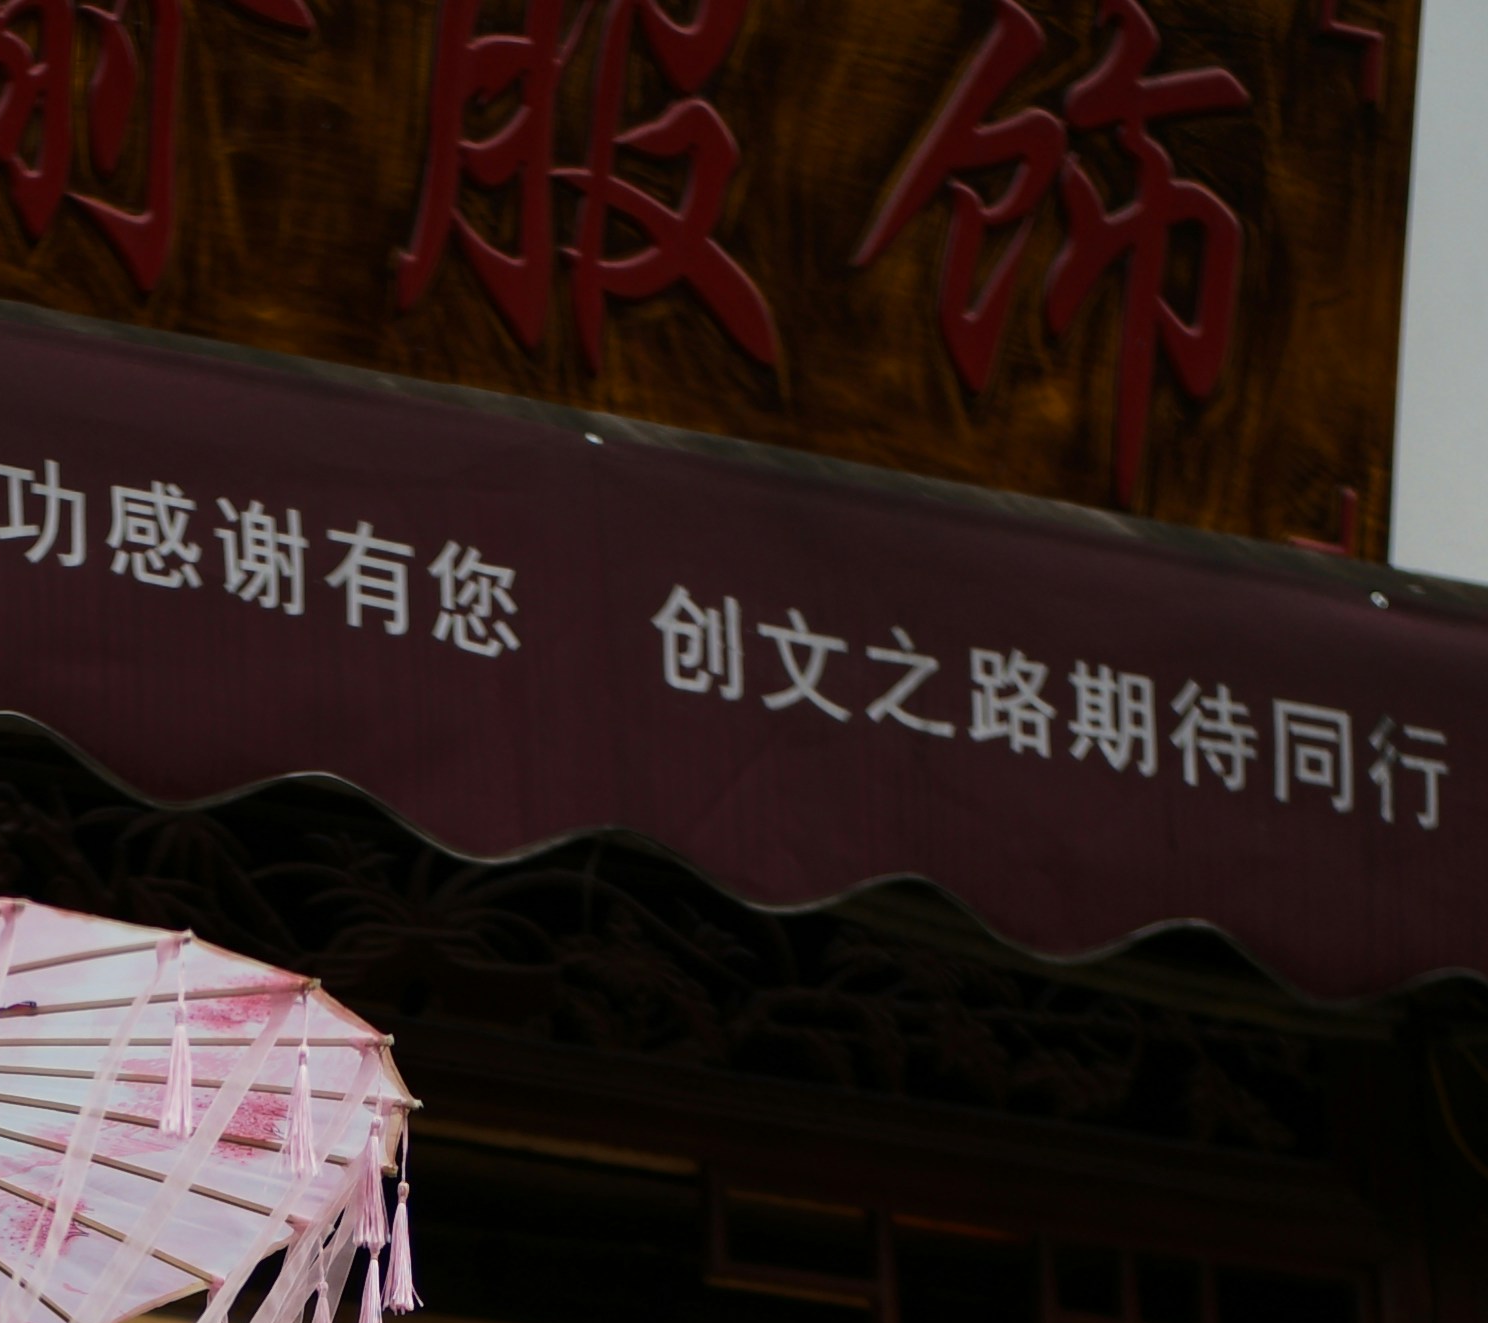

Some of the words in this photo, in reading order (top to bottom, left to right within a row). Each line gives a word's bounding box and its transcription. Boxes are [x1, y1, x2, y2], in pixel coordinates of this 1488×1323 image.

[649, 583, 1451, 832] 创文之路期待同行
